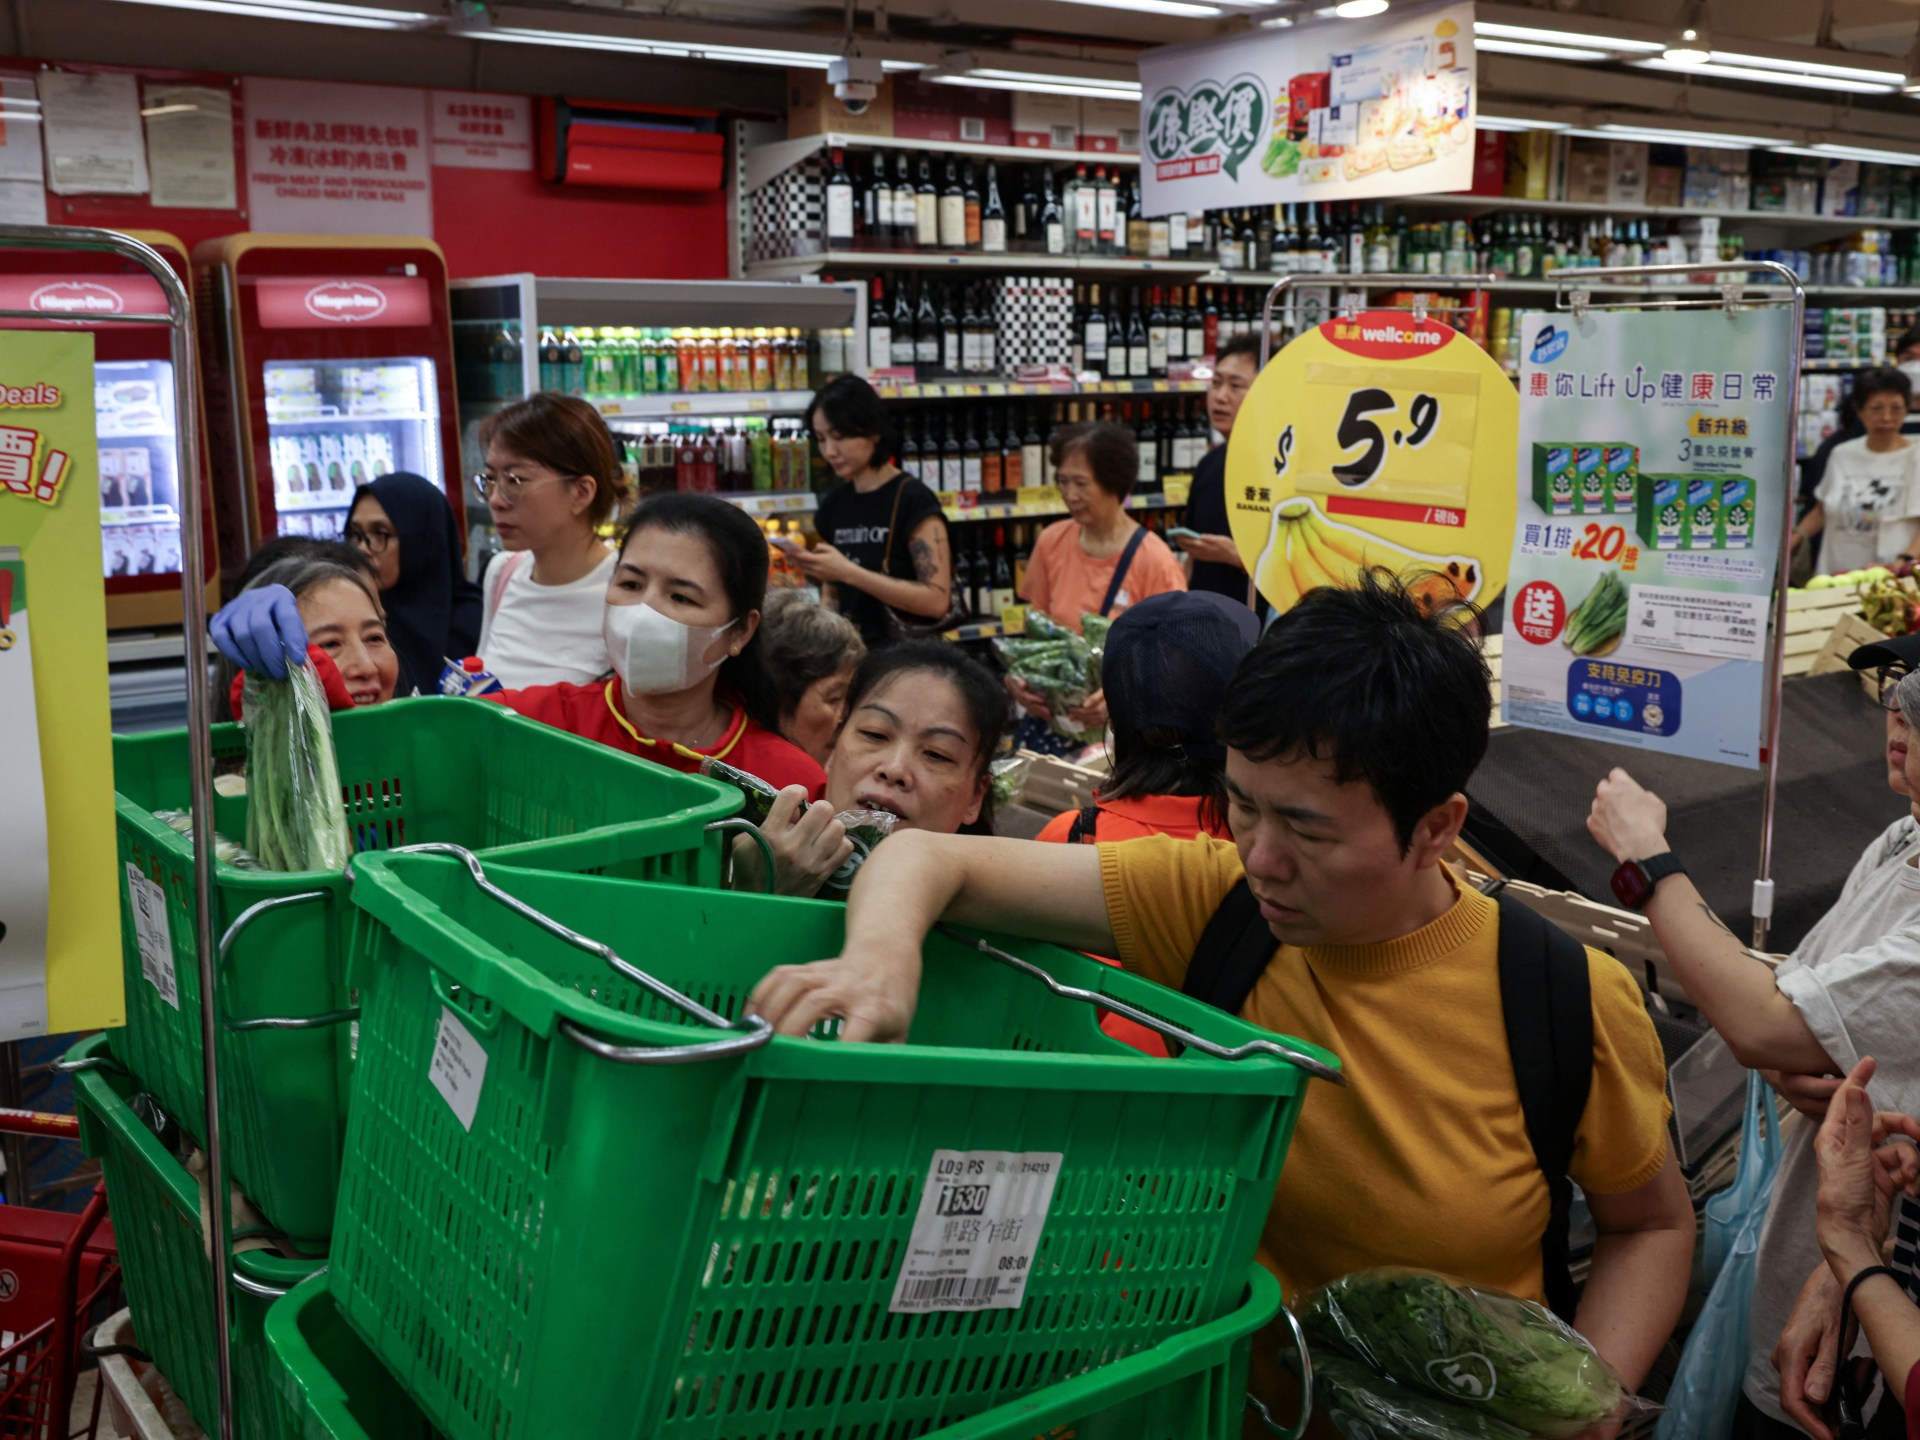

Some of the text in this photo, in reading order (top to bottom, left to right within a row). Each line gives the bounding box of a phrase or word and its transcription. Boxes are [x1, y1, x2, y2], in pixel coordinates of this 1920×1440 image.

[252, 173, 426, 190] FRESH MEAT AND PREPACKAGED
[276, 187, 406, 202] CHILLED MEAT FOR SALE
[1362, 326, 1441, 345] wellcome
[1580, 372, 1616, 397] Lift
[1625, 366, 1656, 404] Up
[1697, 417, 1747, 435] 新升級
[1273, 387, 1441, 490] $ 5.9
[1244, 486, 1271, 502] 香蕉
[1236, 502, 1271, 513] BANANA
[1524, 586, 1555, 627] 送
[1522, 625, 1554, 640] FREE
[1587, 662, 1662, 688] 支持免疫力
[967, 1159, 985, 1174] PS
[938, 1186, 988, 1213] 1530
